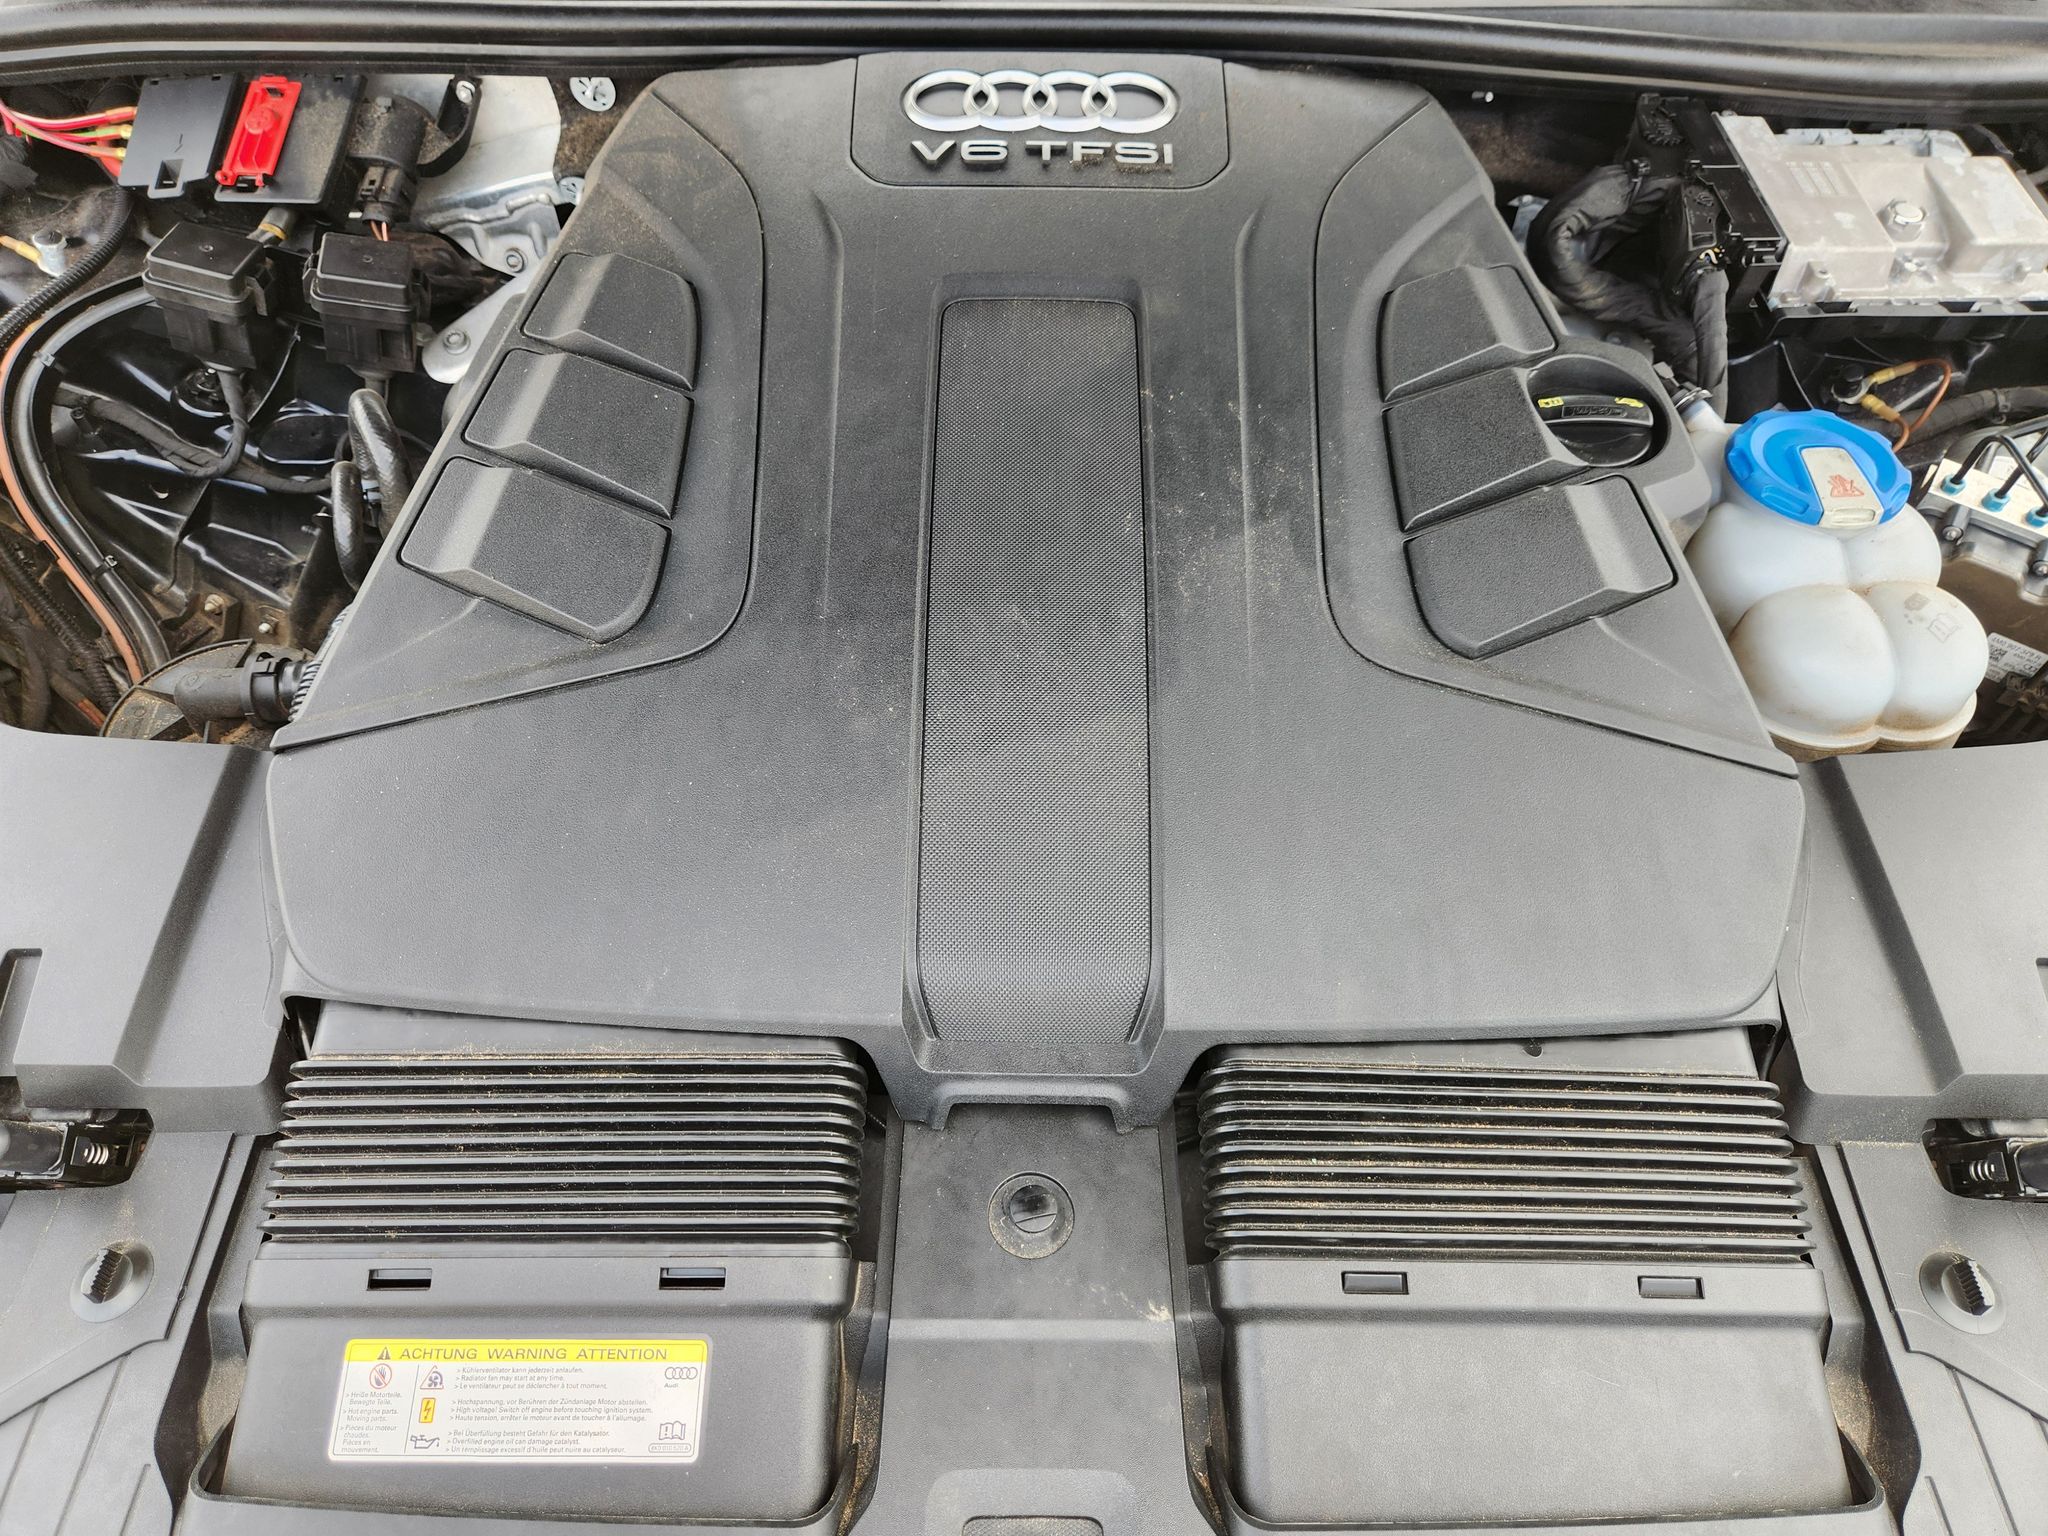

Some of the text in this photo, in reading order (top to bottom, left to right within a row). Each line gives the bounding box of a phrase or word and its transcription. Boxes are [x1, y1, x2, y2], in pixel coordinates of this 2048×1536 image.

[911, 139, 1173, 167] V6 TFSI
[399, 1348, 668, 1361] ACHTUNG WARNING ATTENTION
[560, 1398, 596, 1406] Zündanlage
[465, 1429, 501, 1437] Überfüllung
